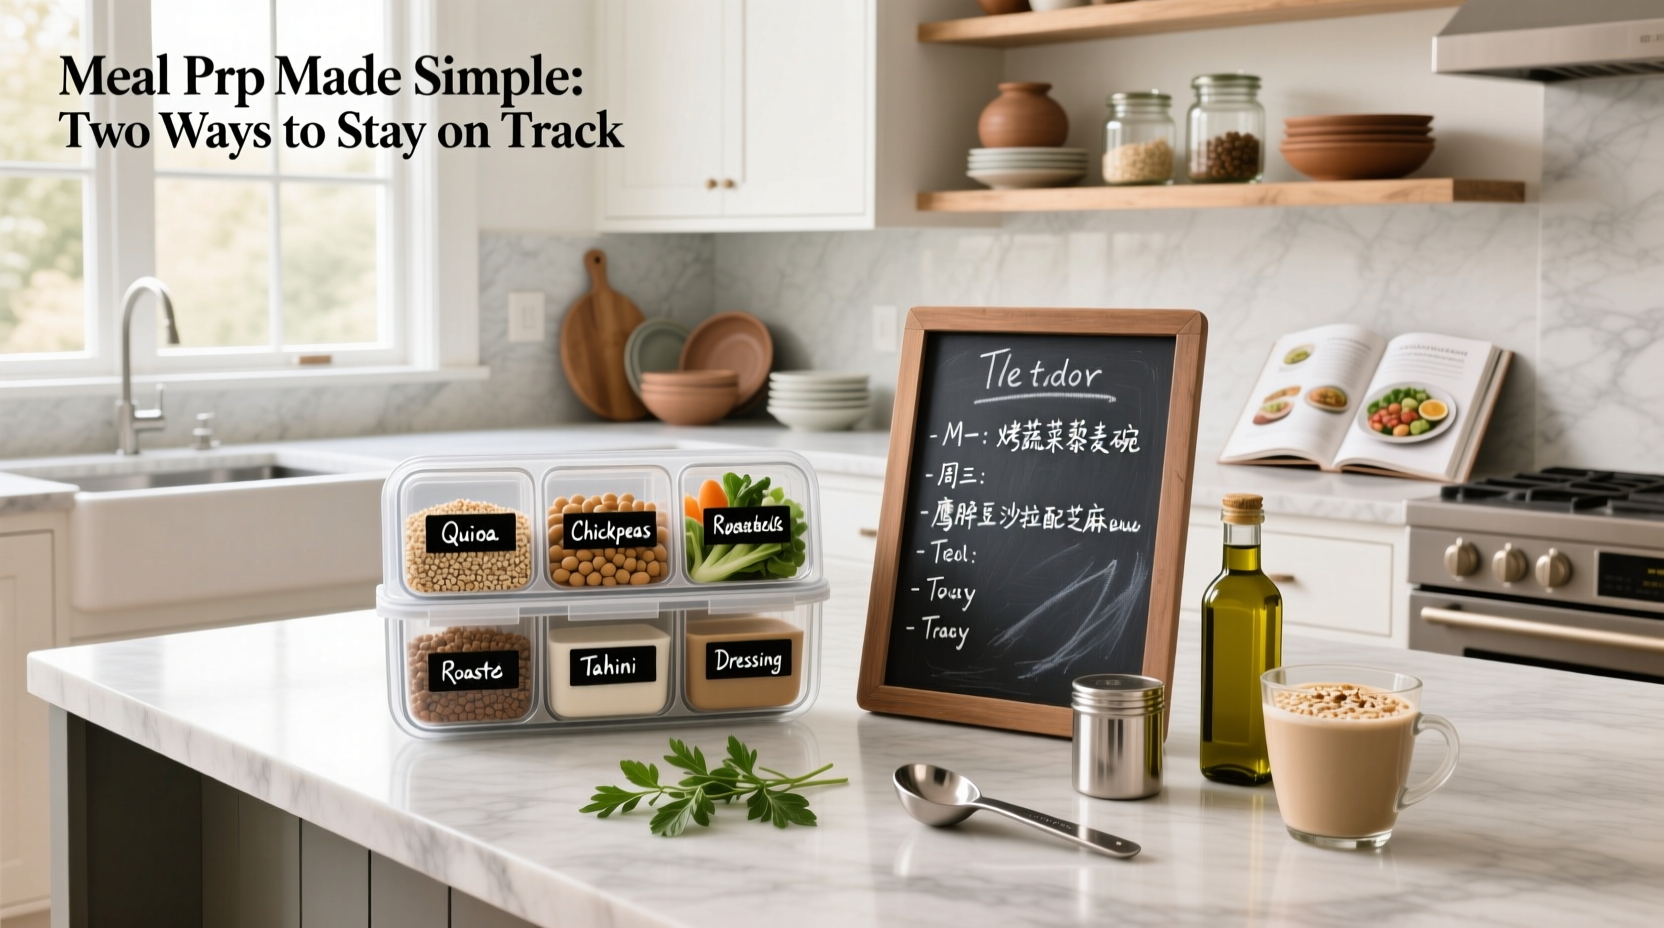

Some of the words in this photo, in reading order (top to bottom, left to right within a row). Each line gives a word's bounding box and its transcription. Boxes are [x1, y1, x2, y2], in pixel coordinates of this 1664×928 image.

[441, 520, 500, 547] Quioa
[571, 519, 651, 546] Chickpeas
[579, 653, 636, 677] Tahini
[714, 648, 782, 675] Dressing
